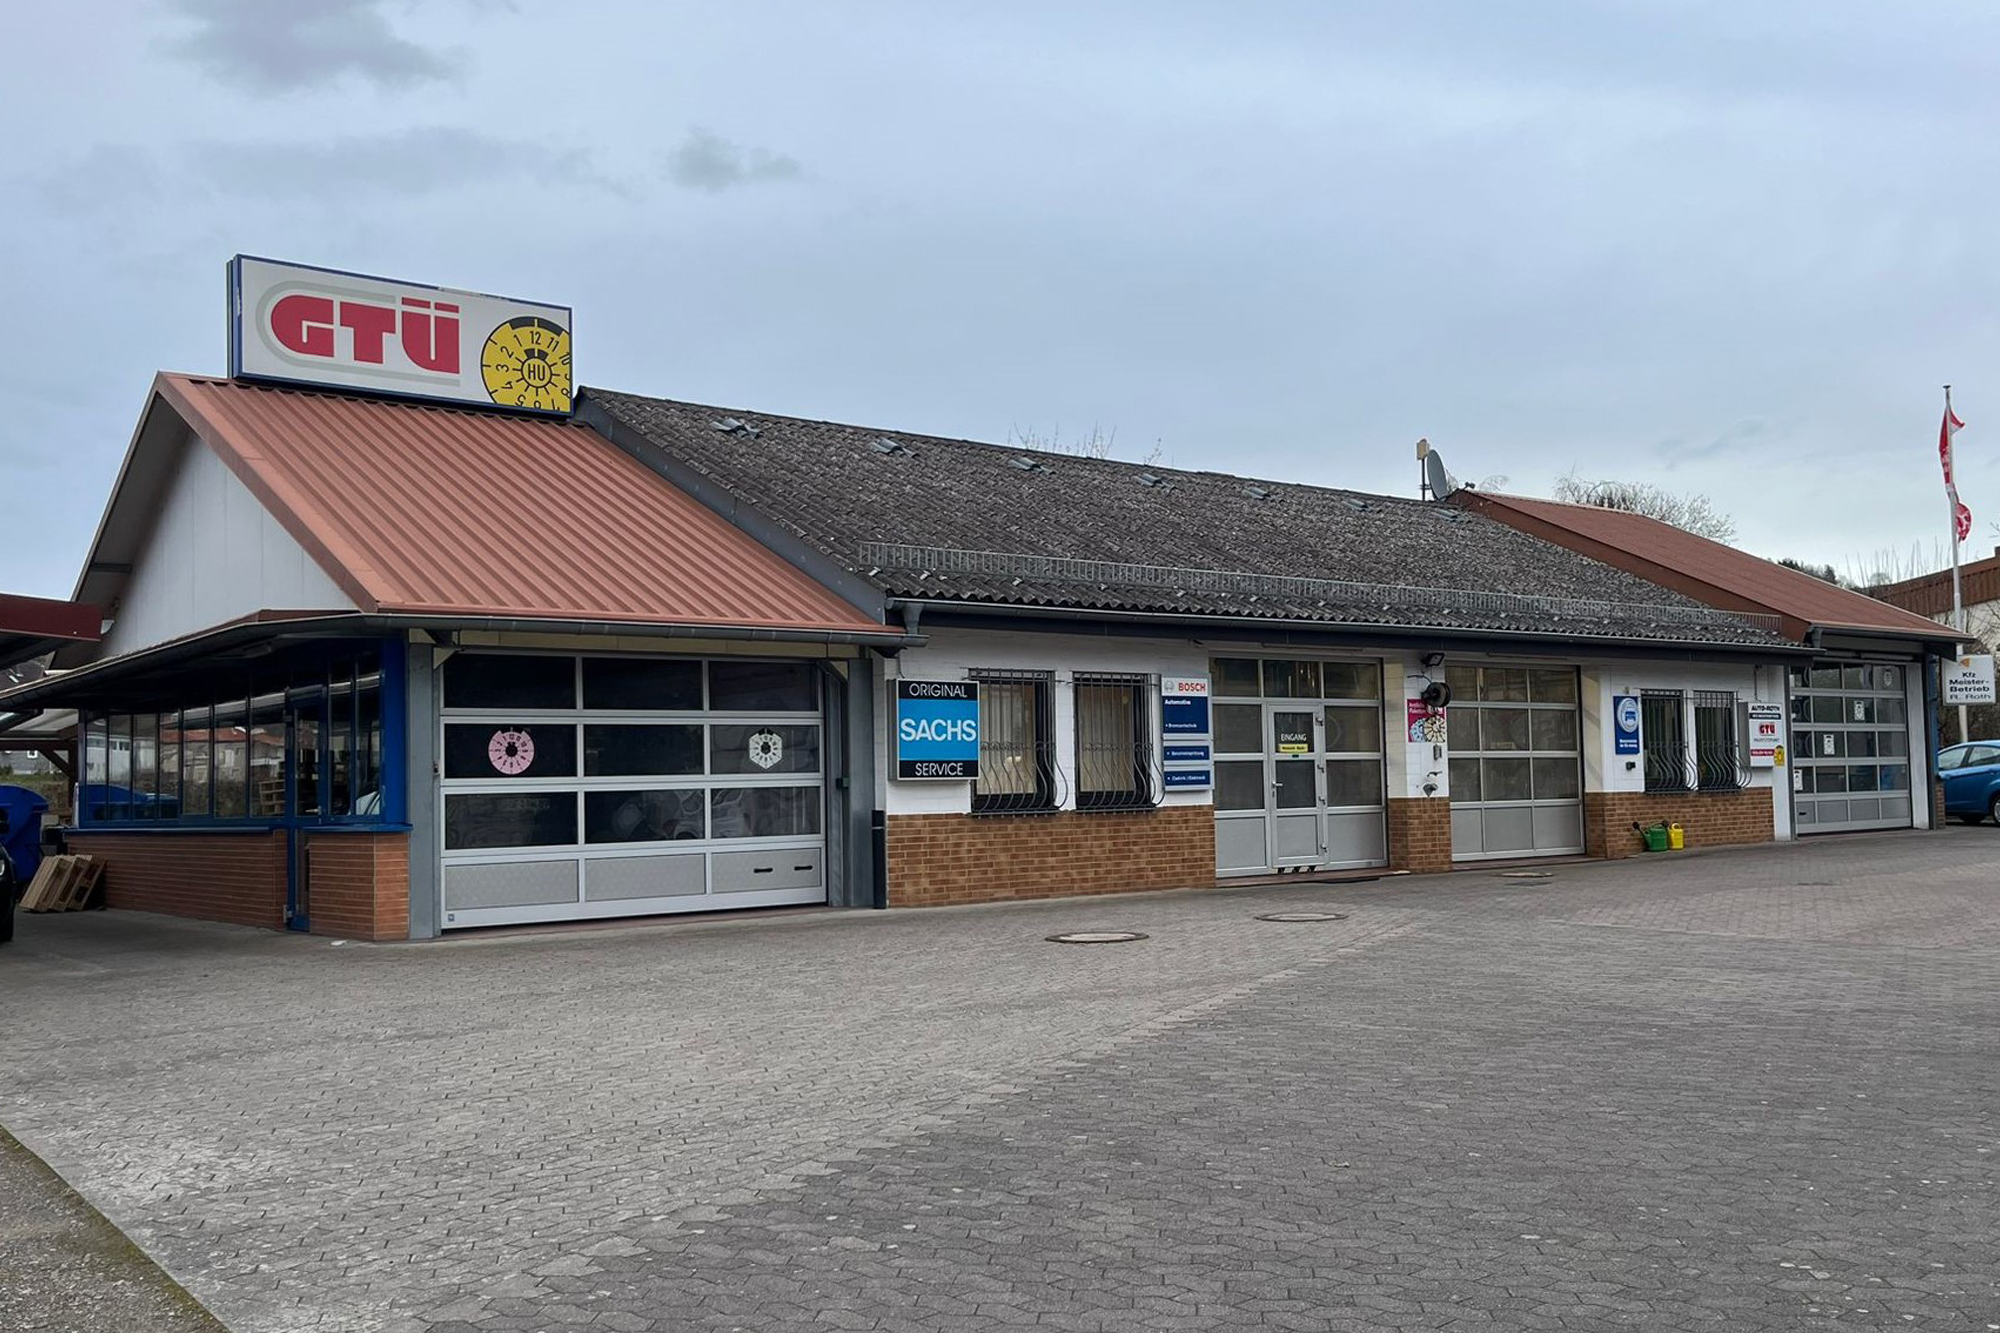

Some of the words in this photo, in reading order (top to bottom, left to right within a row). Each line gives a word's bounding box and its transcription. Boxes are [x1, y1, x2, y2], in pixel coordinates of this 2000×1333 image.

[271, 295, 460, 374] GTÜ
[529, 331, 541, 345] 12
[500, 346, 514, 358] 2
[496, 364, 509, 372] 3
[527, 363, 546, 381] HU
[909, 683, 968, 698] ORIGINAL
[1178, 682, 1206, 692] BOSCH
[900, 718, 977, 742] SACHS
[1280, 733, 1307, 741] EINGANG
[915, 762, 964, 776] SERVICE
